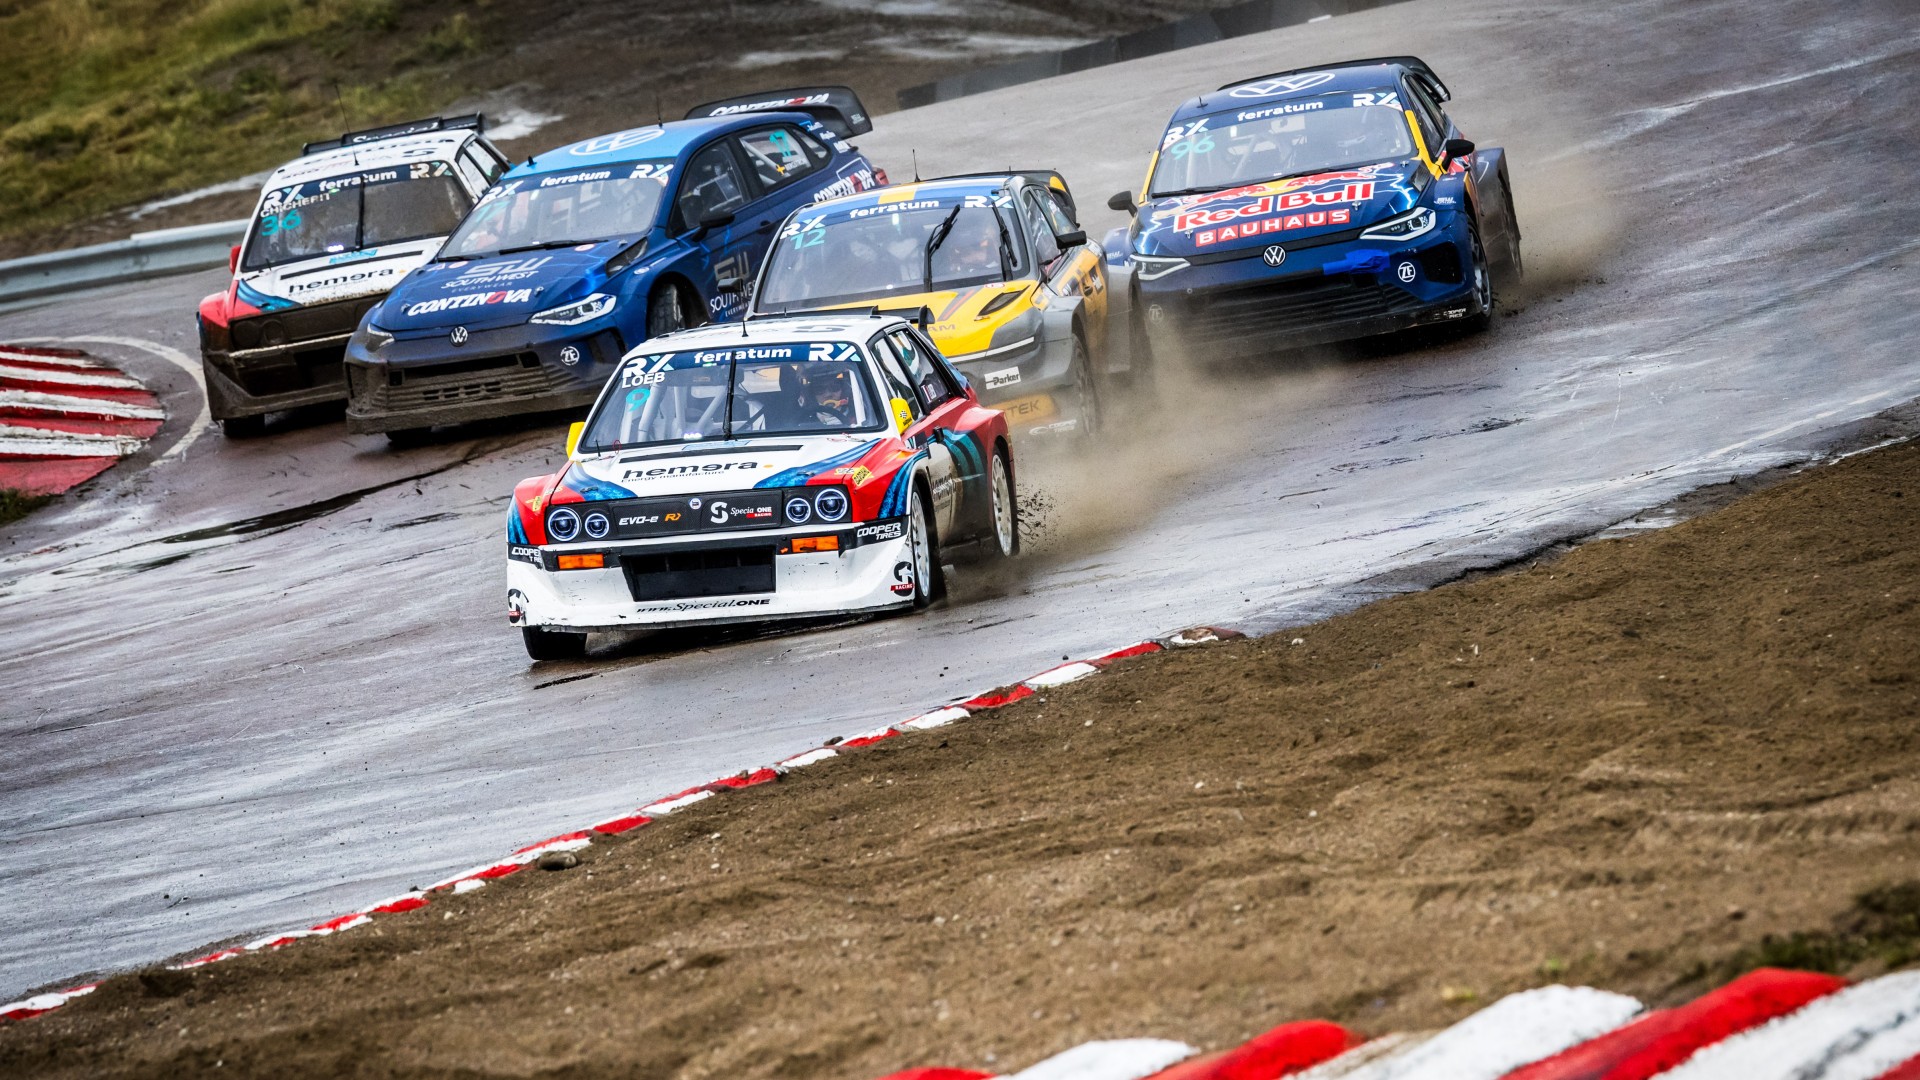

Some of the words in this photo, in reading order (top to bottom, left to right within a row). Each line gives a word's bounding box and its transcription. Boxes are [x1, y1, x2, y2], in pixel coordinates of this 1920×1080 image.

[1353, 92, 1399, 107] RX
[1238, 101, 1323, 122] ferratum
[1171, 135, 1216, 160] 96
[409, 161, 454, 179] RX
[540, 170, 611, 187] ferratum
[629, 164, 674, 179] RX
[319, 169, 398, 192] ferratum
[263, 184, 304, 209] RX
[964, 195, 1014, 208] RX
[849, 200, 939, 219] ferratum
[1174, 195, 1273, 233] Red
[1277, 182, 1375, 212] Bull
[262, 208, 302, 236] 36
[780, 214, 827, 239] RX
[1200, 210, 1349, 244] BAUHAUS
[790, 229, 826, 250] 12
[407, 288, 533, 316] CONTINOVA
[694, 348, 792, 364] ferratum
[808, 343, 861, 362] RX
[622, 353, 676, 378] RX
[621, 372, 665, 389] LOEB
[991, 373, 1020, 386] Parker
[626, 388, 650, 412] 9
[857, 522, 901, 538] COOPER
[876, 530, 901, 541] TIRES
